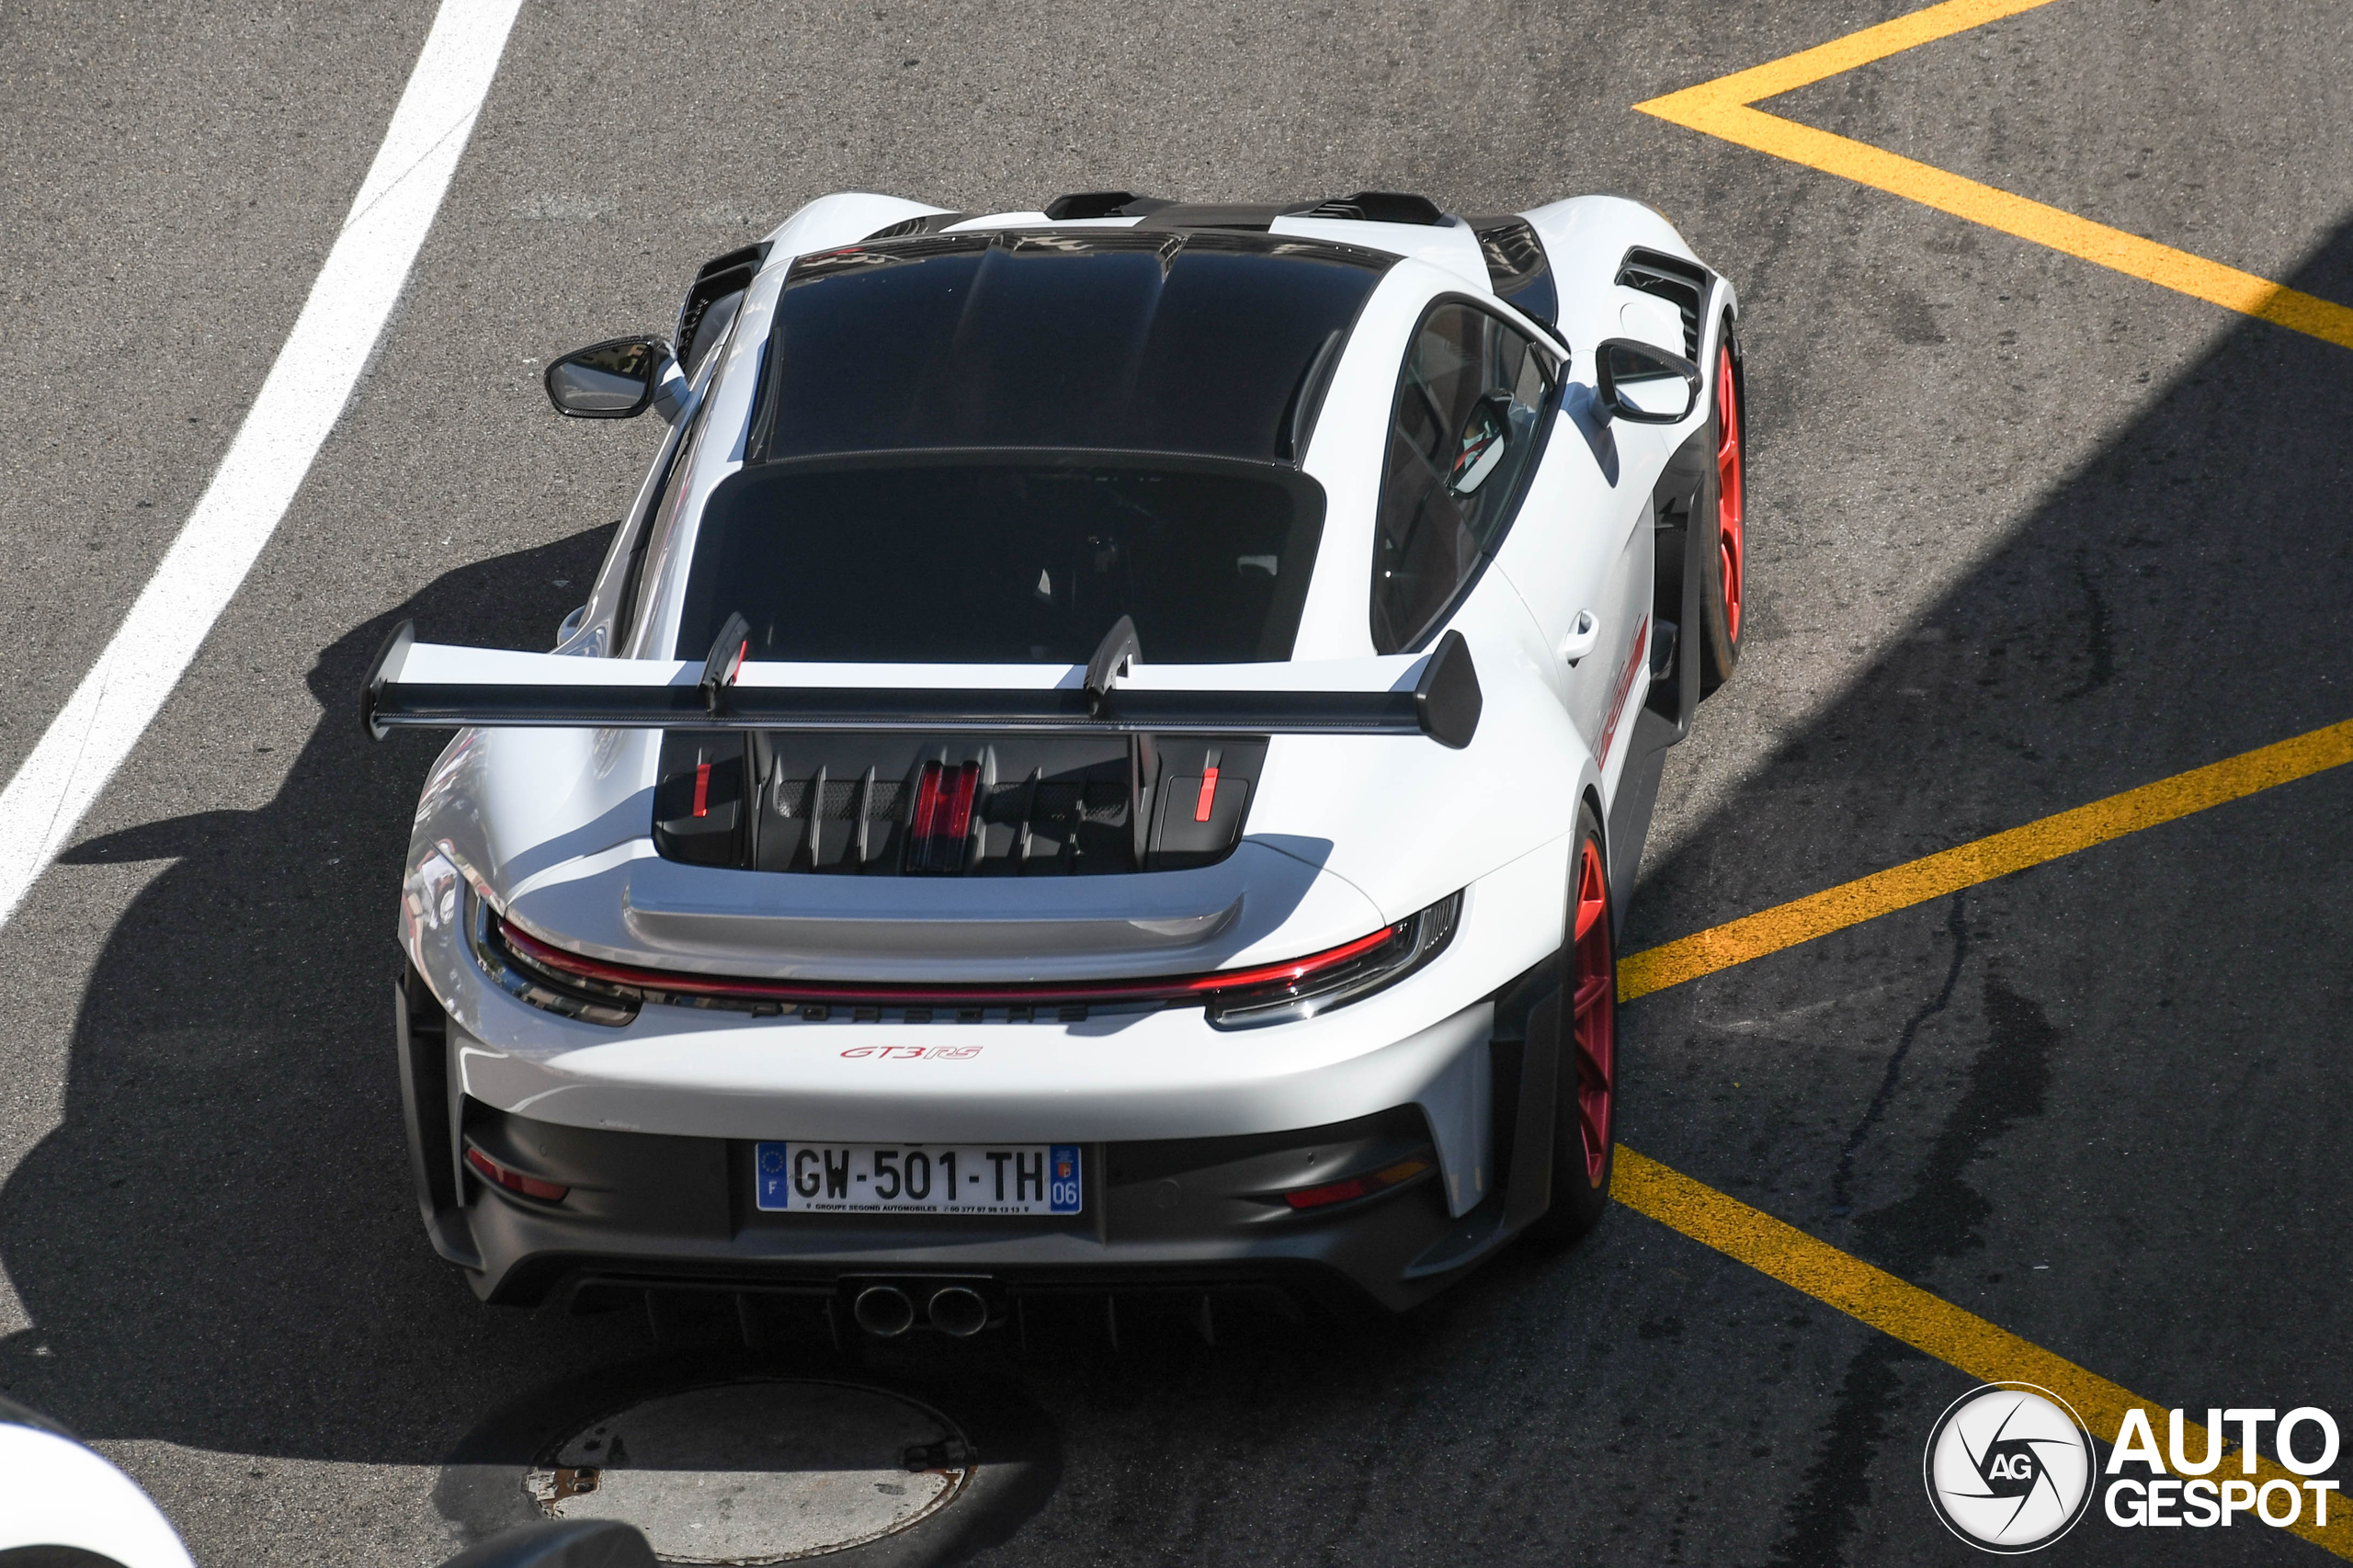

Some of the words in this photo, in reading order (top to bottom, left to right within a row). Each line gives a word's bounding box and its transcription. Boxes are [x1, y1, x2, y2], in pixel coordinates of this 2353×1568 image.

[794, 1149, 1043, 1201] GW-501-TH
[768, 1181, 778, 1195] F
[1052, 1182, 1077, 1205] 06
[815, 1203, 847, 1211] GROUPE
[882, 1204, 938, 1212] AUTOMOBILES
